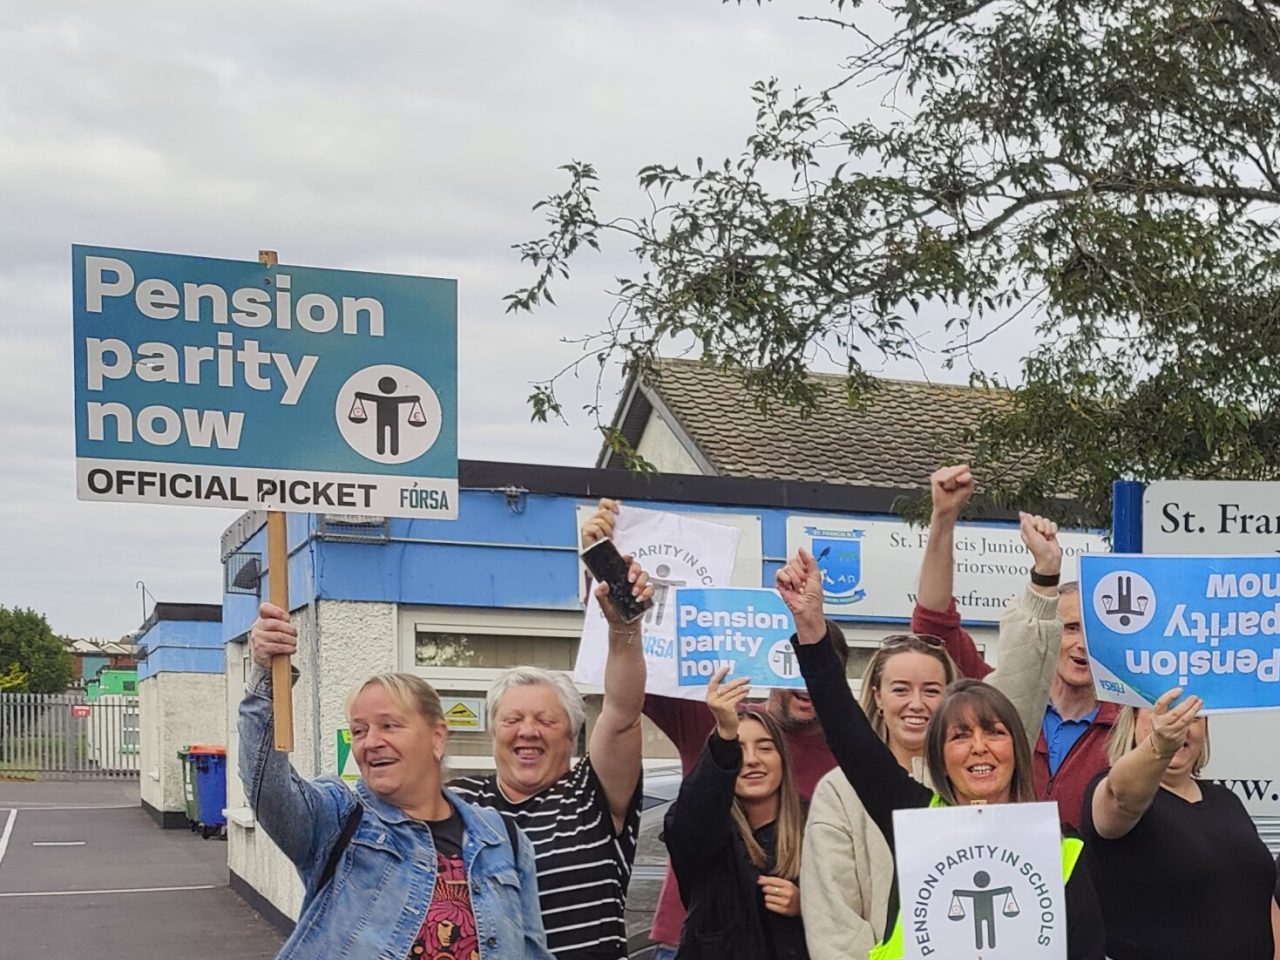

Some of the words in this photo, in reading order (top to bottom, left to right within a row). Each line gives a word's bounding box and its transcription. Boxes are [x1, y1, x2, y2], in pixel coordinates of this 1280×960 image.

[85, 256, 385, 336] Pension
[86, 332, 319, 405] parity
[86, 401, 245, 450] now
[87, 468, 249, 502] OFFICIAL
[257, 477, 377, 508] PICKET
[399, 482, 449, 511] FÓRSA
[1160, 502, 1206, 534] St.
[890, 532, 912, 548] St.
[683, 552, 699, 567] IN
[680, 605, 789, 630] Pension
[681, 629, 764, 658] parity
[681, 659, 736, 677] now
[1126, 649, 1280, 686] Pension
[914, 873, 939, 957] PENSION
[935, 845, 999, 876] PARITY
[1000, 849, 1020, 867] IN
[1019, 862, 1054, 947] SCHOOLS
